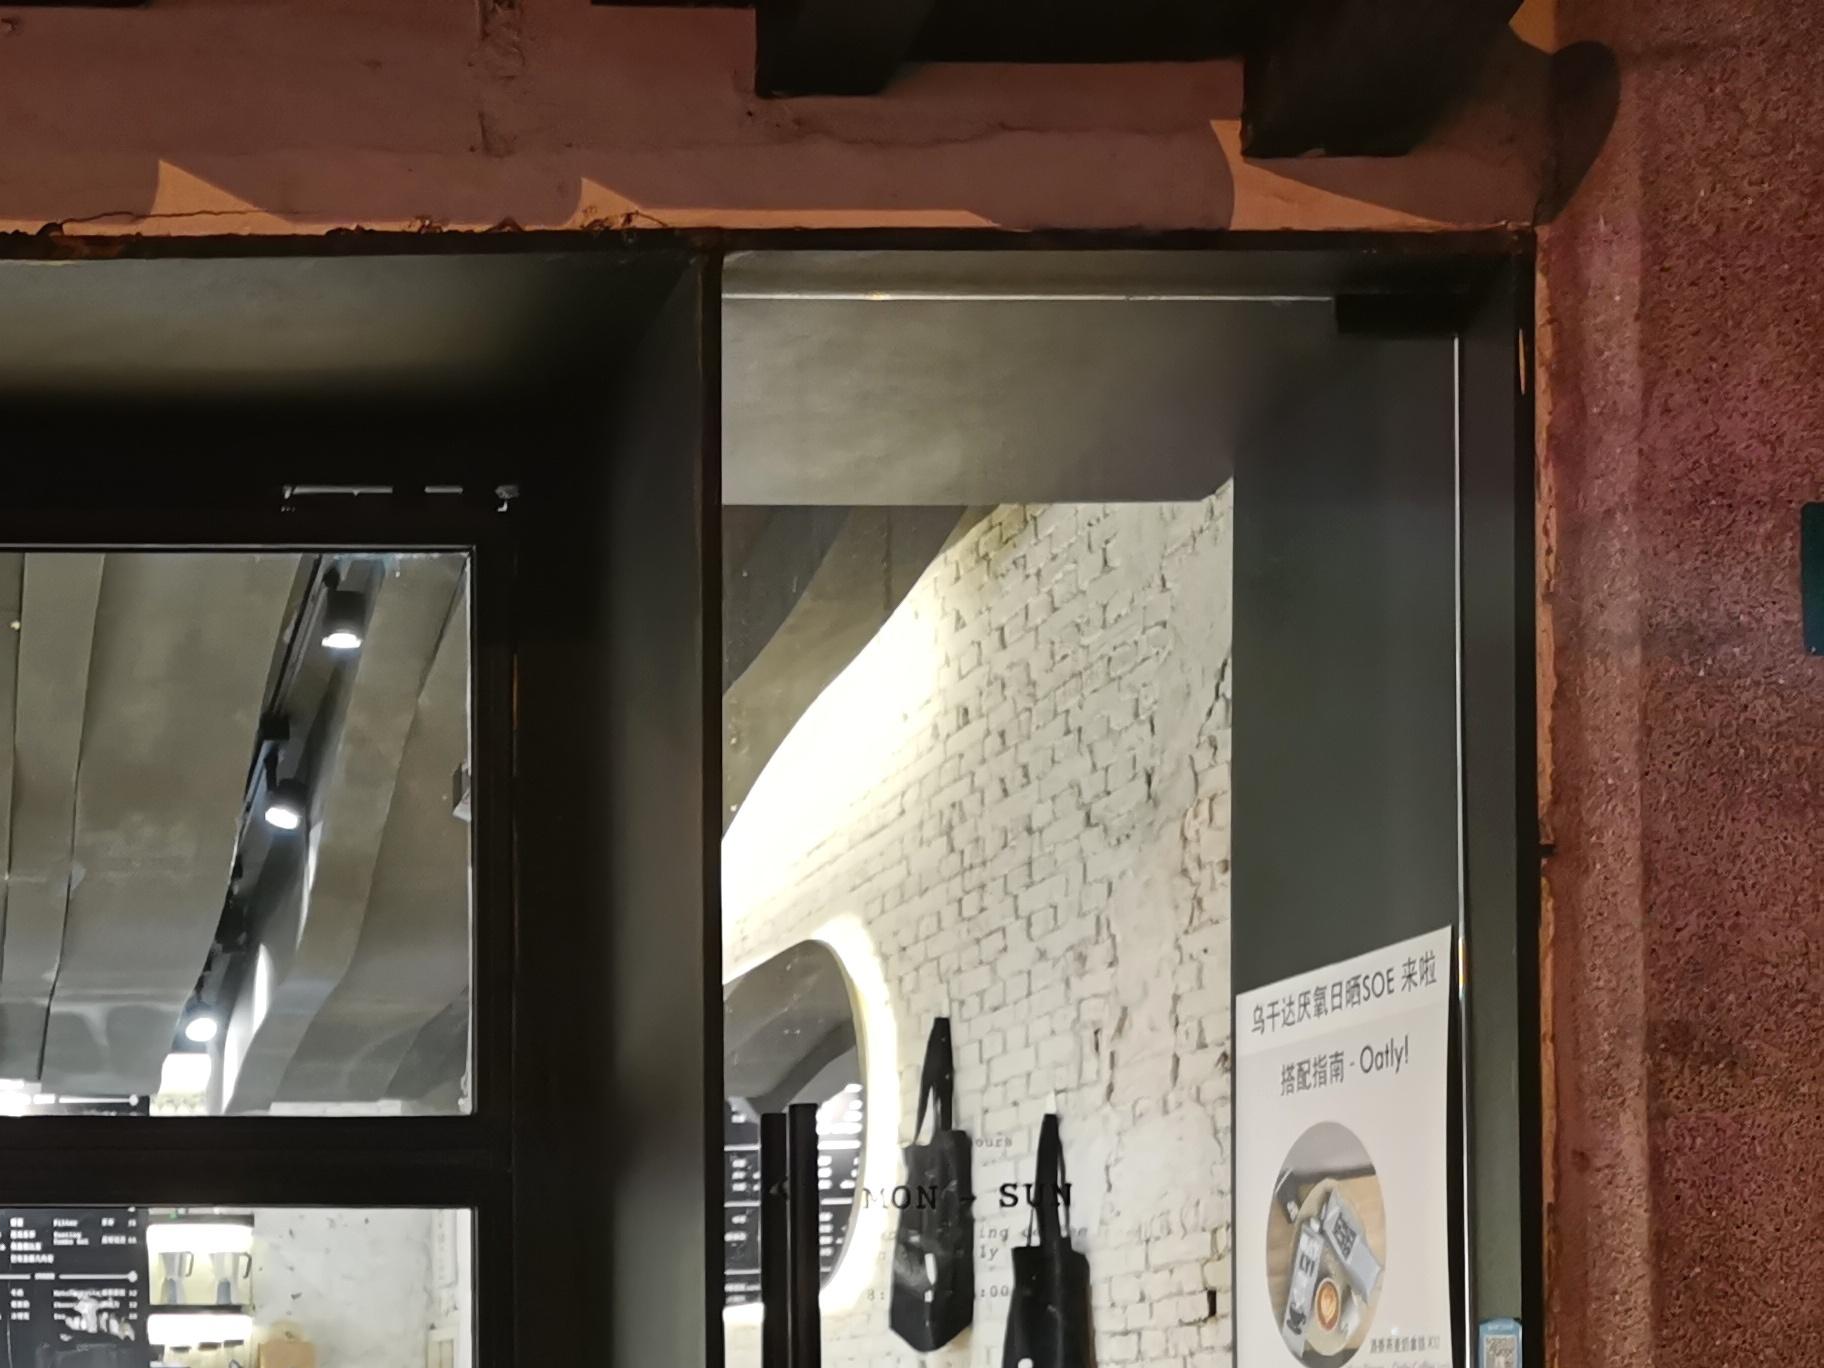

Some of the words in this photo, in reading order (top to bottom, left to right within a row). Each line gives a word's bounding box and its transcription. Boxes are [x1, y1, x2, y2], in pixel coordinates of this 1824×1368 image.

[1250, 967, 1395, 1035] 乌干达厌氧日晒SOE
[1400, 949, 1438, 993] 来啦
[1280, 1051, 1345, 1096] 搭配指南
[1360, 1035, 1409, 1074] Oatly!
[862, 1185, 938, 1210] MON
